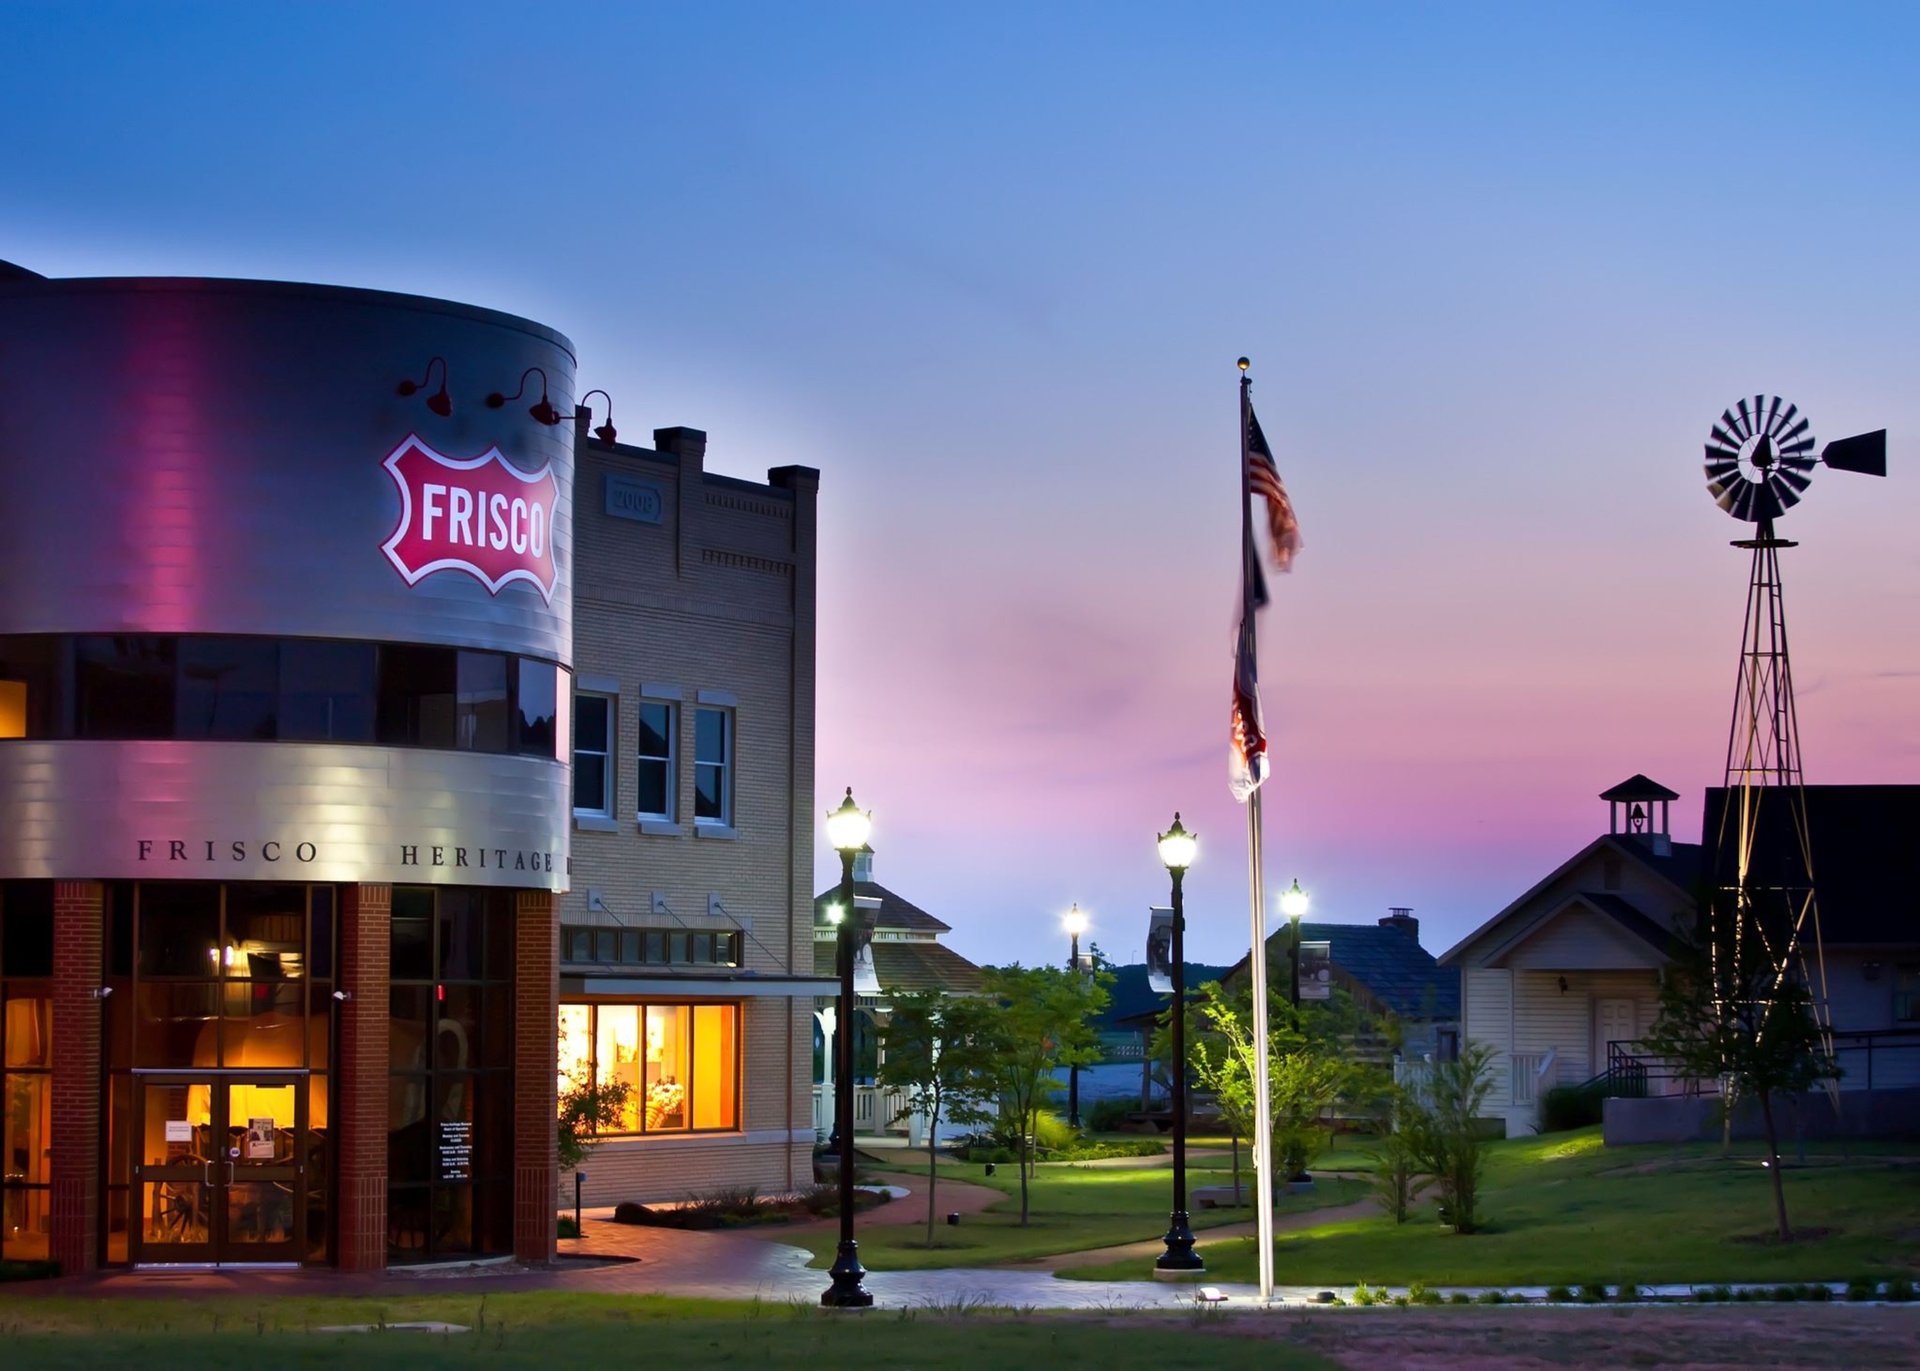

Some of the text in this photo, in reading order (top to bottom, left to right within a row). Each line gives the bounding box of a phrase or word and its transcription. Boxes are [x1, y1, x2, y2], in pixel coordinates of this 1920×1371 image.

[422, 483, 544, 558] FRISCO
[137, 840, 317, 862] FRISCO
[401, 845, 552, 872] HERITAGE
